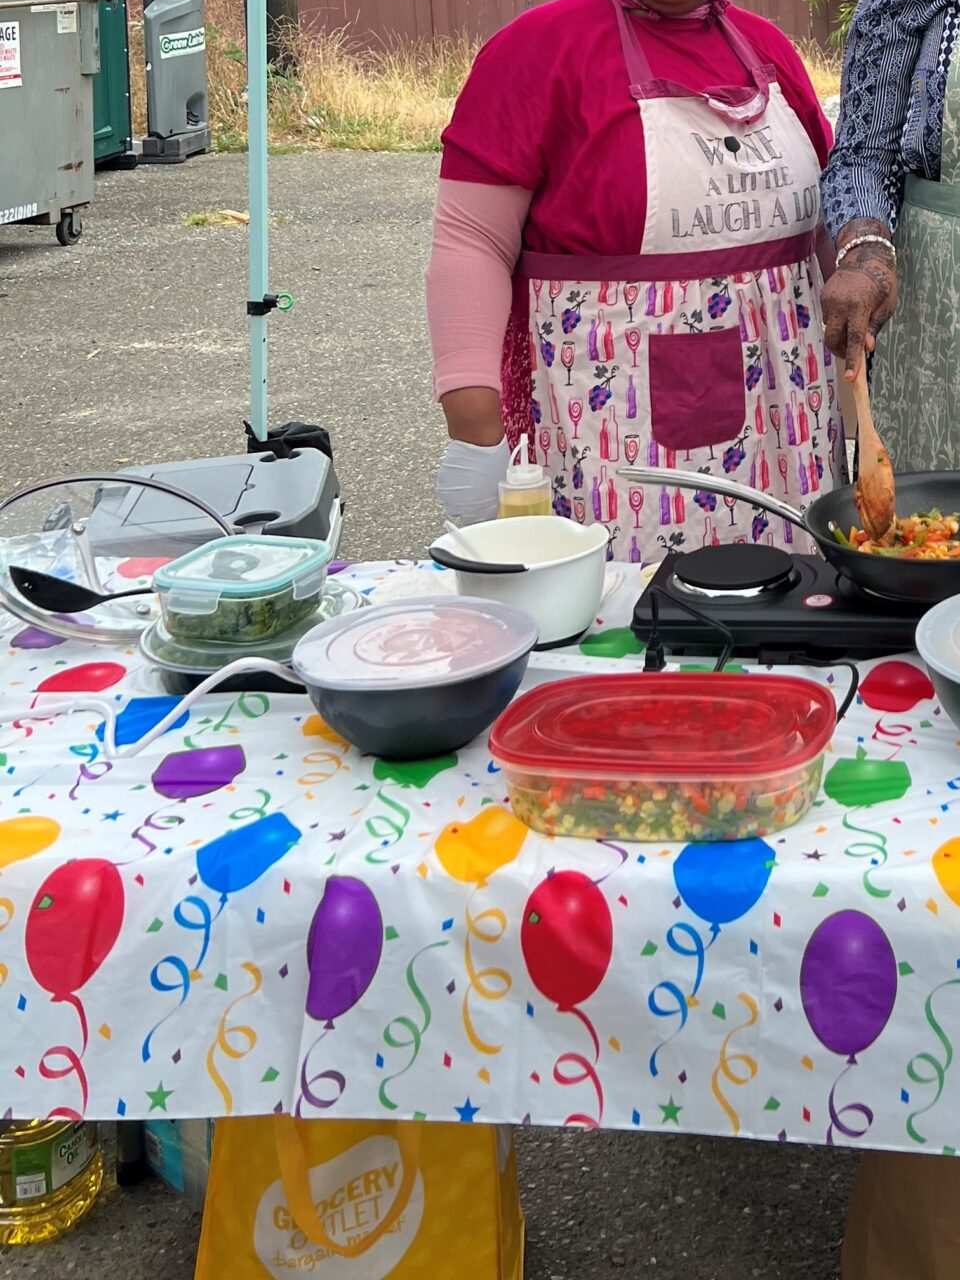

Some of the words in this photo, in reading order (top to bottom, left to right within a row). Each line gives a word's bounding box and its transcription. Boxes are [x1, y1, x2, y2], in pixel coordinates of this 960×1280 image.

[161, 36, 188, 54] Green
[705, 176, 723, 197] A
[726, 166, 794, 195] LITTLE
[670, 199, 762, 238] LAUGH
[768, 196, 789, 228] A
